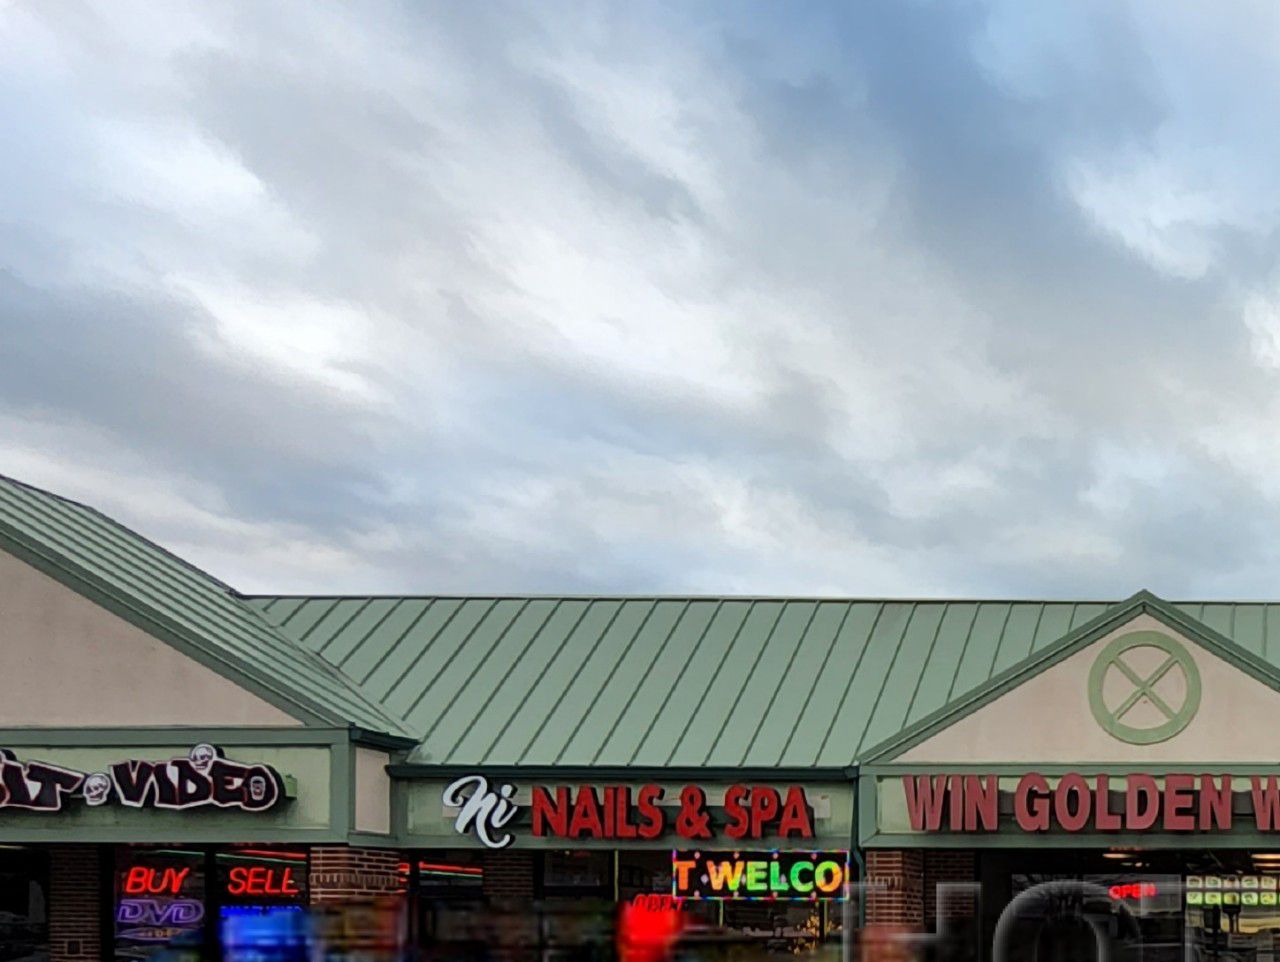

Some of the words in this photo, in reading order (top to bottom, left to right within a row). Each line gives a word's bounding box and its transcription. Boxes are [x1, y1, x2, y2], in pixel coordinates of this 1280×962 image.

[110, 756, 279, 811] VIDEO
[532, 784, 663, 839] NAILS
[676, 785, 712, 838] &
[723, 784, 813, 838] SPA
[903, 773, 999, 832] WIN
[1014, 772, 1232, 832] GOLDEN
[125, 866, 190, 894] BUY
[227, 867, 299, 895] SELL
[706, 861, 842, 892] WELCO
[116, 899, 205, 925] DVD
